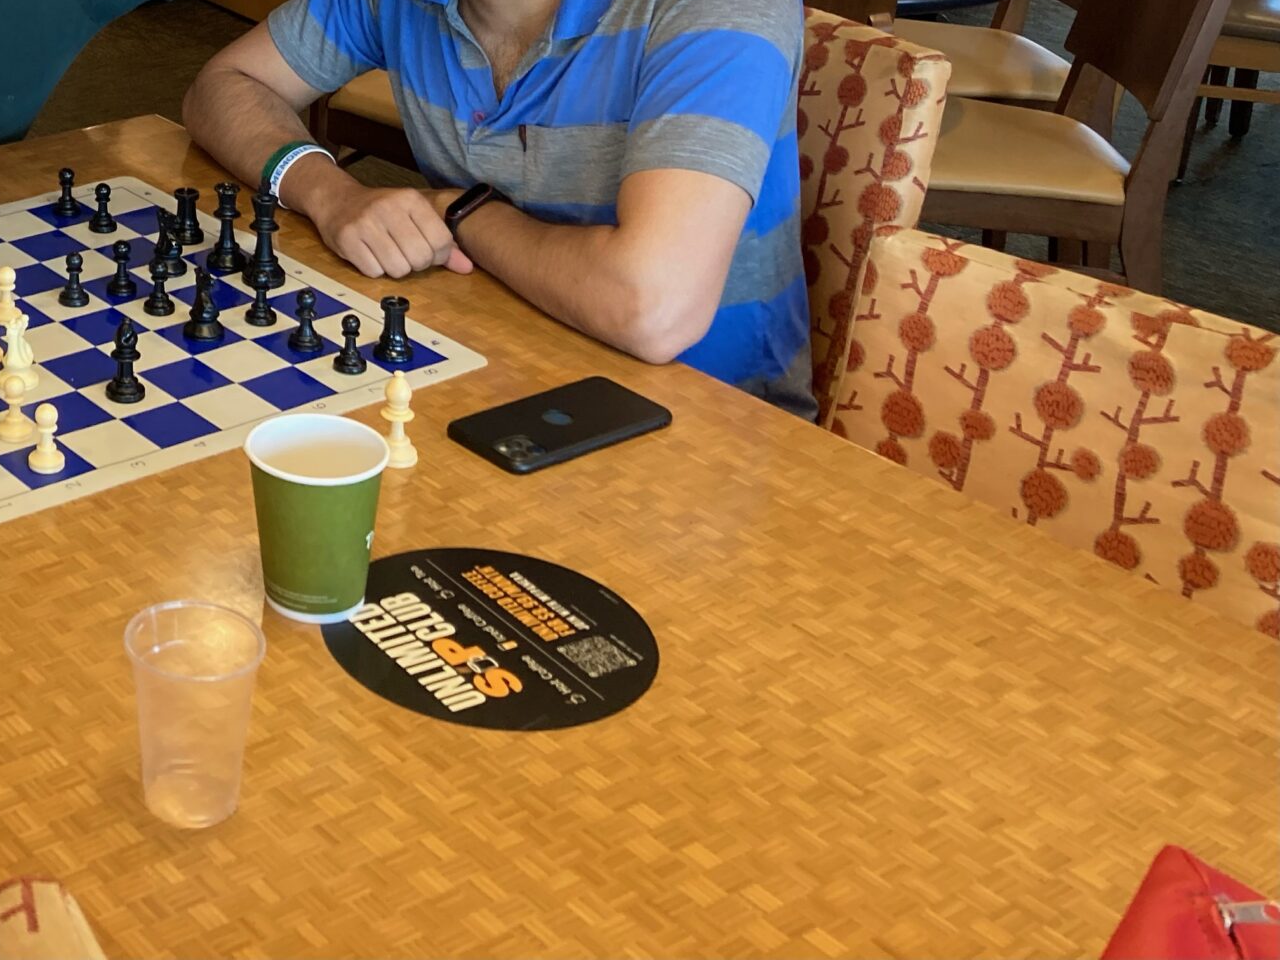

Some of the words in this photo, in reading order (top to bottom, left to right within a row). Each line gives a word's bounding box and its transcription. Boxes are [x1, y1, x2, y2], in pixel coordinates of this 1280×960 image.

[461, 570, 504, 599] COFFEE
[379, 592, 456, 642] CLUB
[496, 597, 559, 642] UNLIMITED
[546, 618, 576, 637] FOR
[347, 603, 486, 713] UNLIMITED
